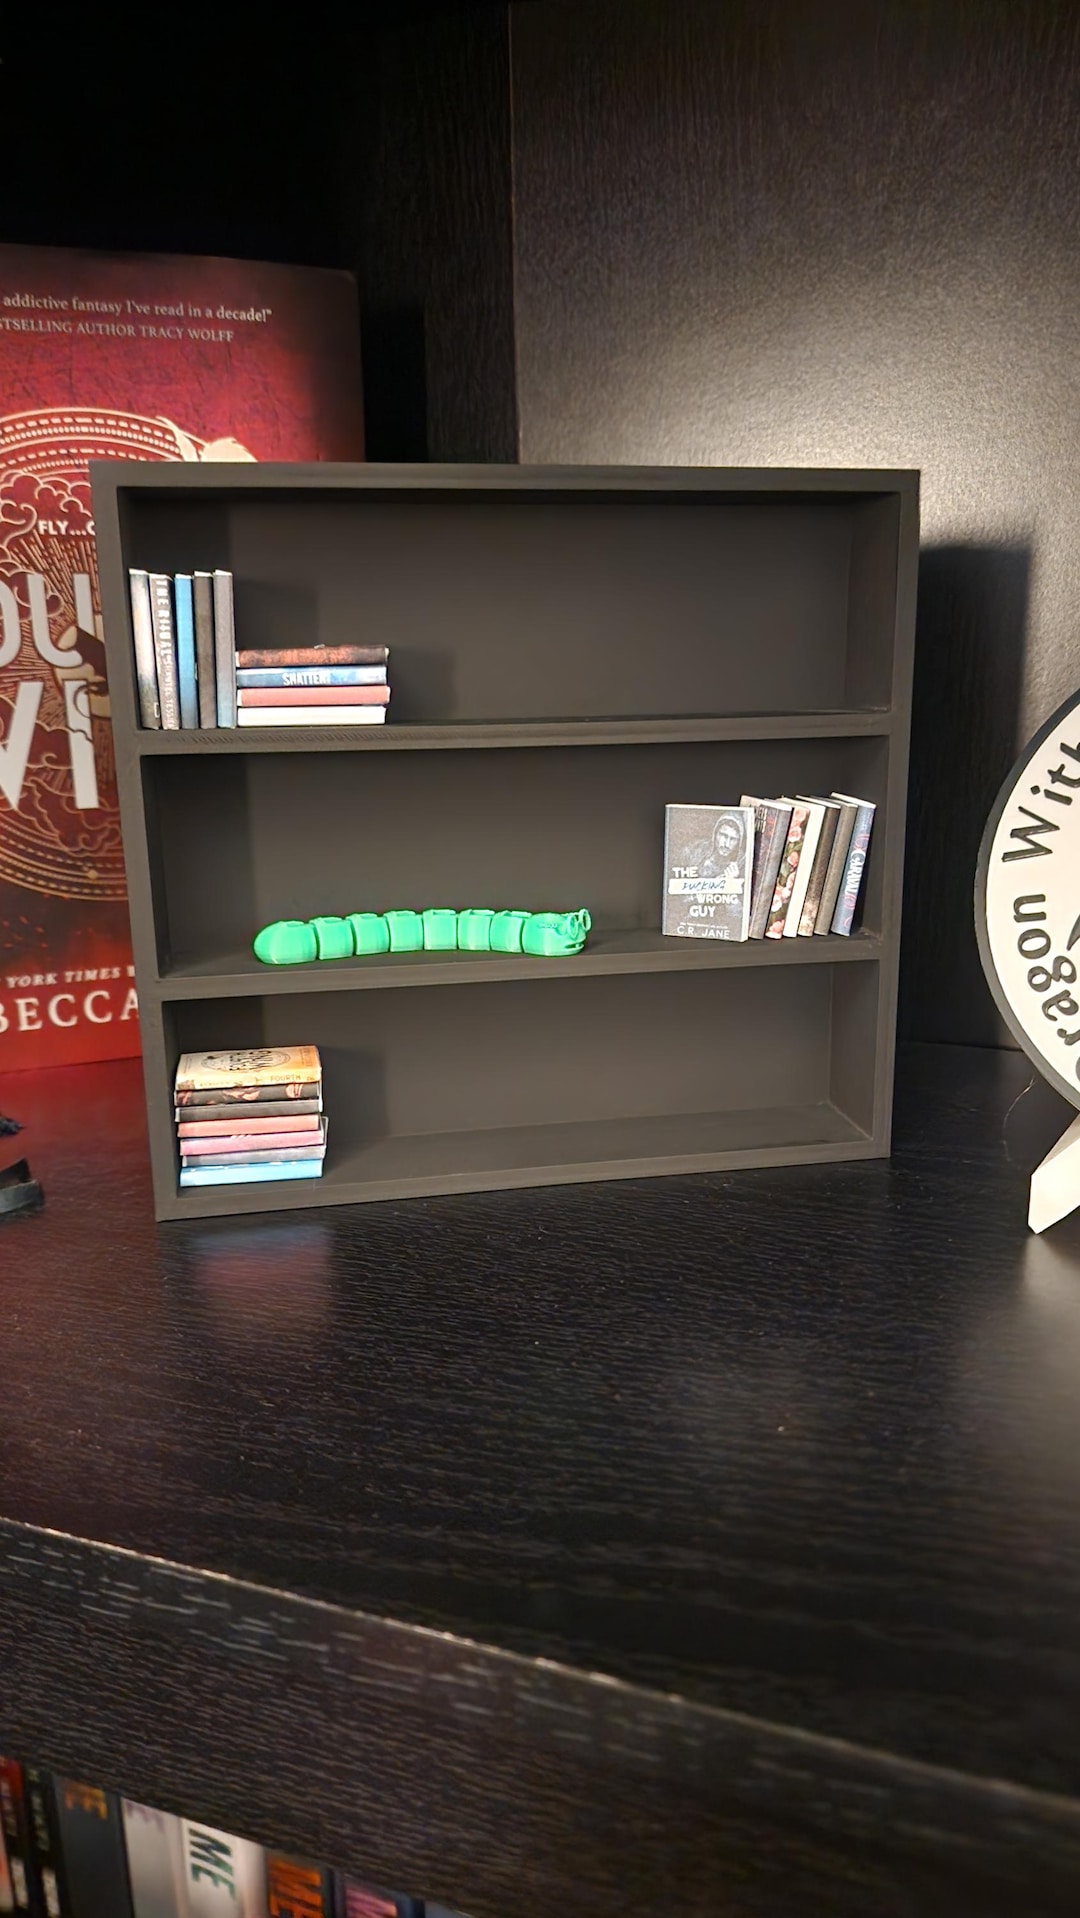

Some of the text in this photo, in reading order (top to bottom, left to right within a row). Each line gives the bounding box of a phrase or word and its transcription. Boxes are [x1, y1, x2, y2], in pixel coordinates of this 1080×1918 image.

[3, 293, 69, 310] addictive
[71, 296, 121, 316] fantasy
[126, 299, 150, 315] I've
[155, 302, 184, 317] read
[189, 302, 202, 317] in
[205, 307, 213, 319] a
[0, 317, 234, 342] TSELLING AUTHOR TRACY WOLFF
[155, 580, 169, 606] THE
[672, 866, 698, 878] THE
[844, 849, 866, 896] CARAVAL
[682, 880, 726, 891] FUCKING
[696, 893, 738, 905] WRONG
[689, 905, 715, 917] GUY
[702, 928, 731, 939] JANE
[6, 973, 58, 988] YORK
[65, 967, 121, 983] TIMES
[1014, 894, 1080, 1082] ragon
